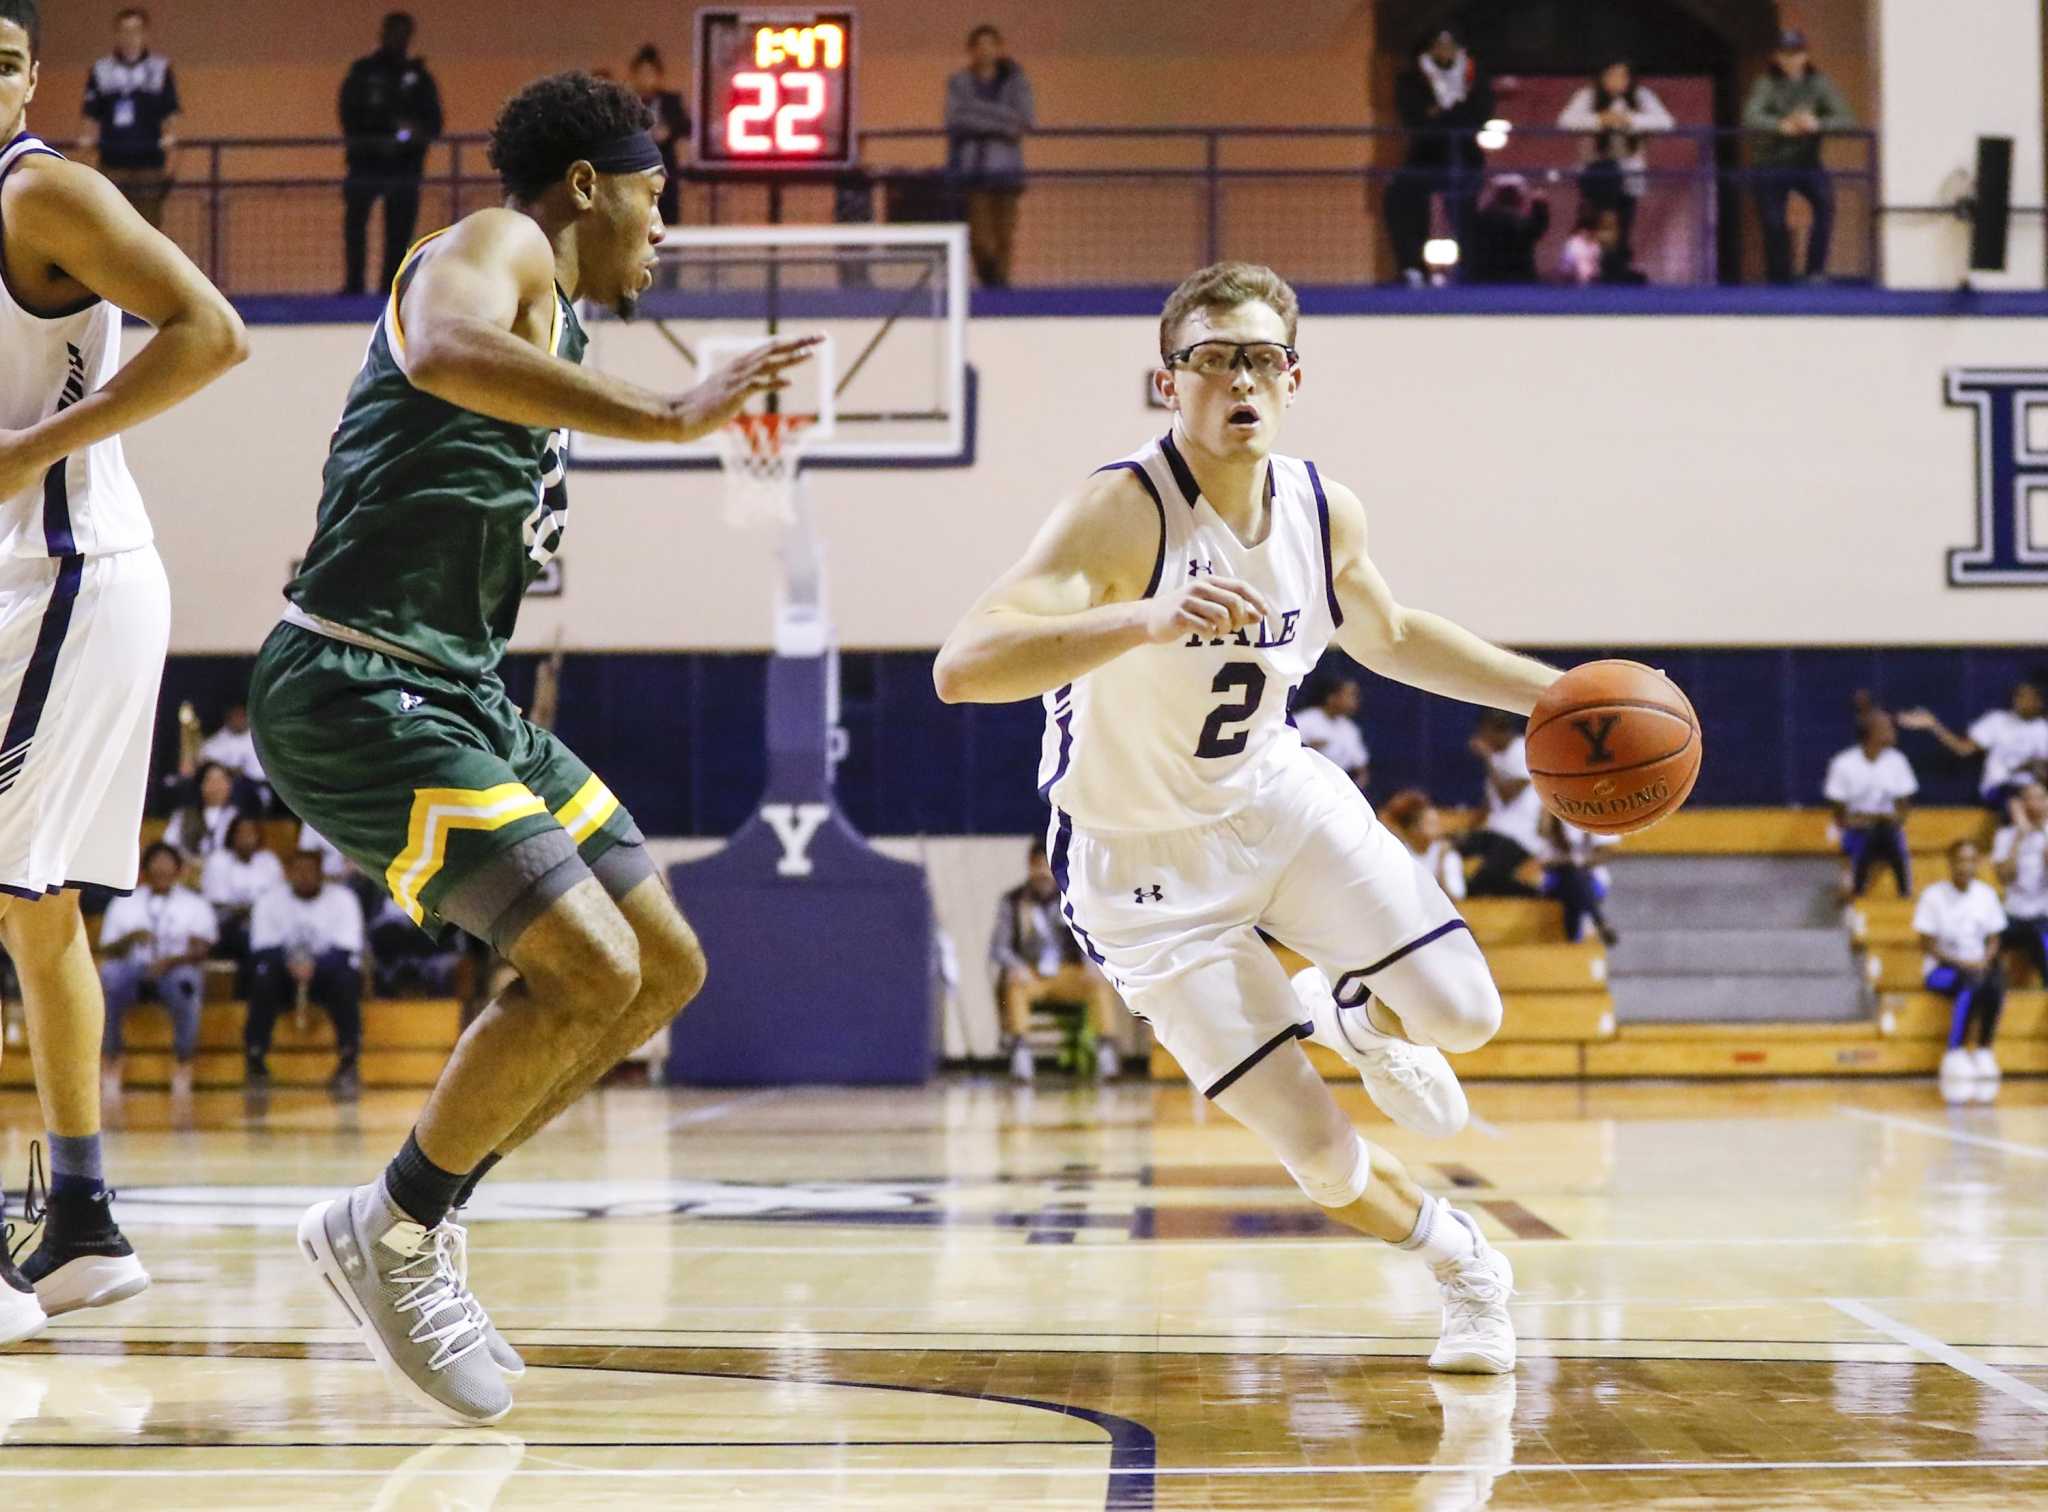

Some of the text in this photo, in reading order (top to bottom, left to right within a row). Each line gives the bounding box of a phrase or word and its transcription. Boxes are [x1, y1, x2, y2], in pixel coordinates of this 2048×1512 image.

[756, 24, 843, 69] 1:47
[728, 72, 824, 152] 22
[1194, 662, 1267, 759] 2
[1571, 713, 1622, 767] Y
[1554, 776, 1669, 817] SPALDING
[760, 804, 830, 875] Y
